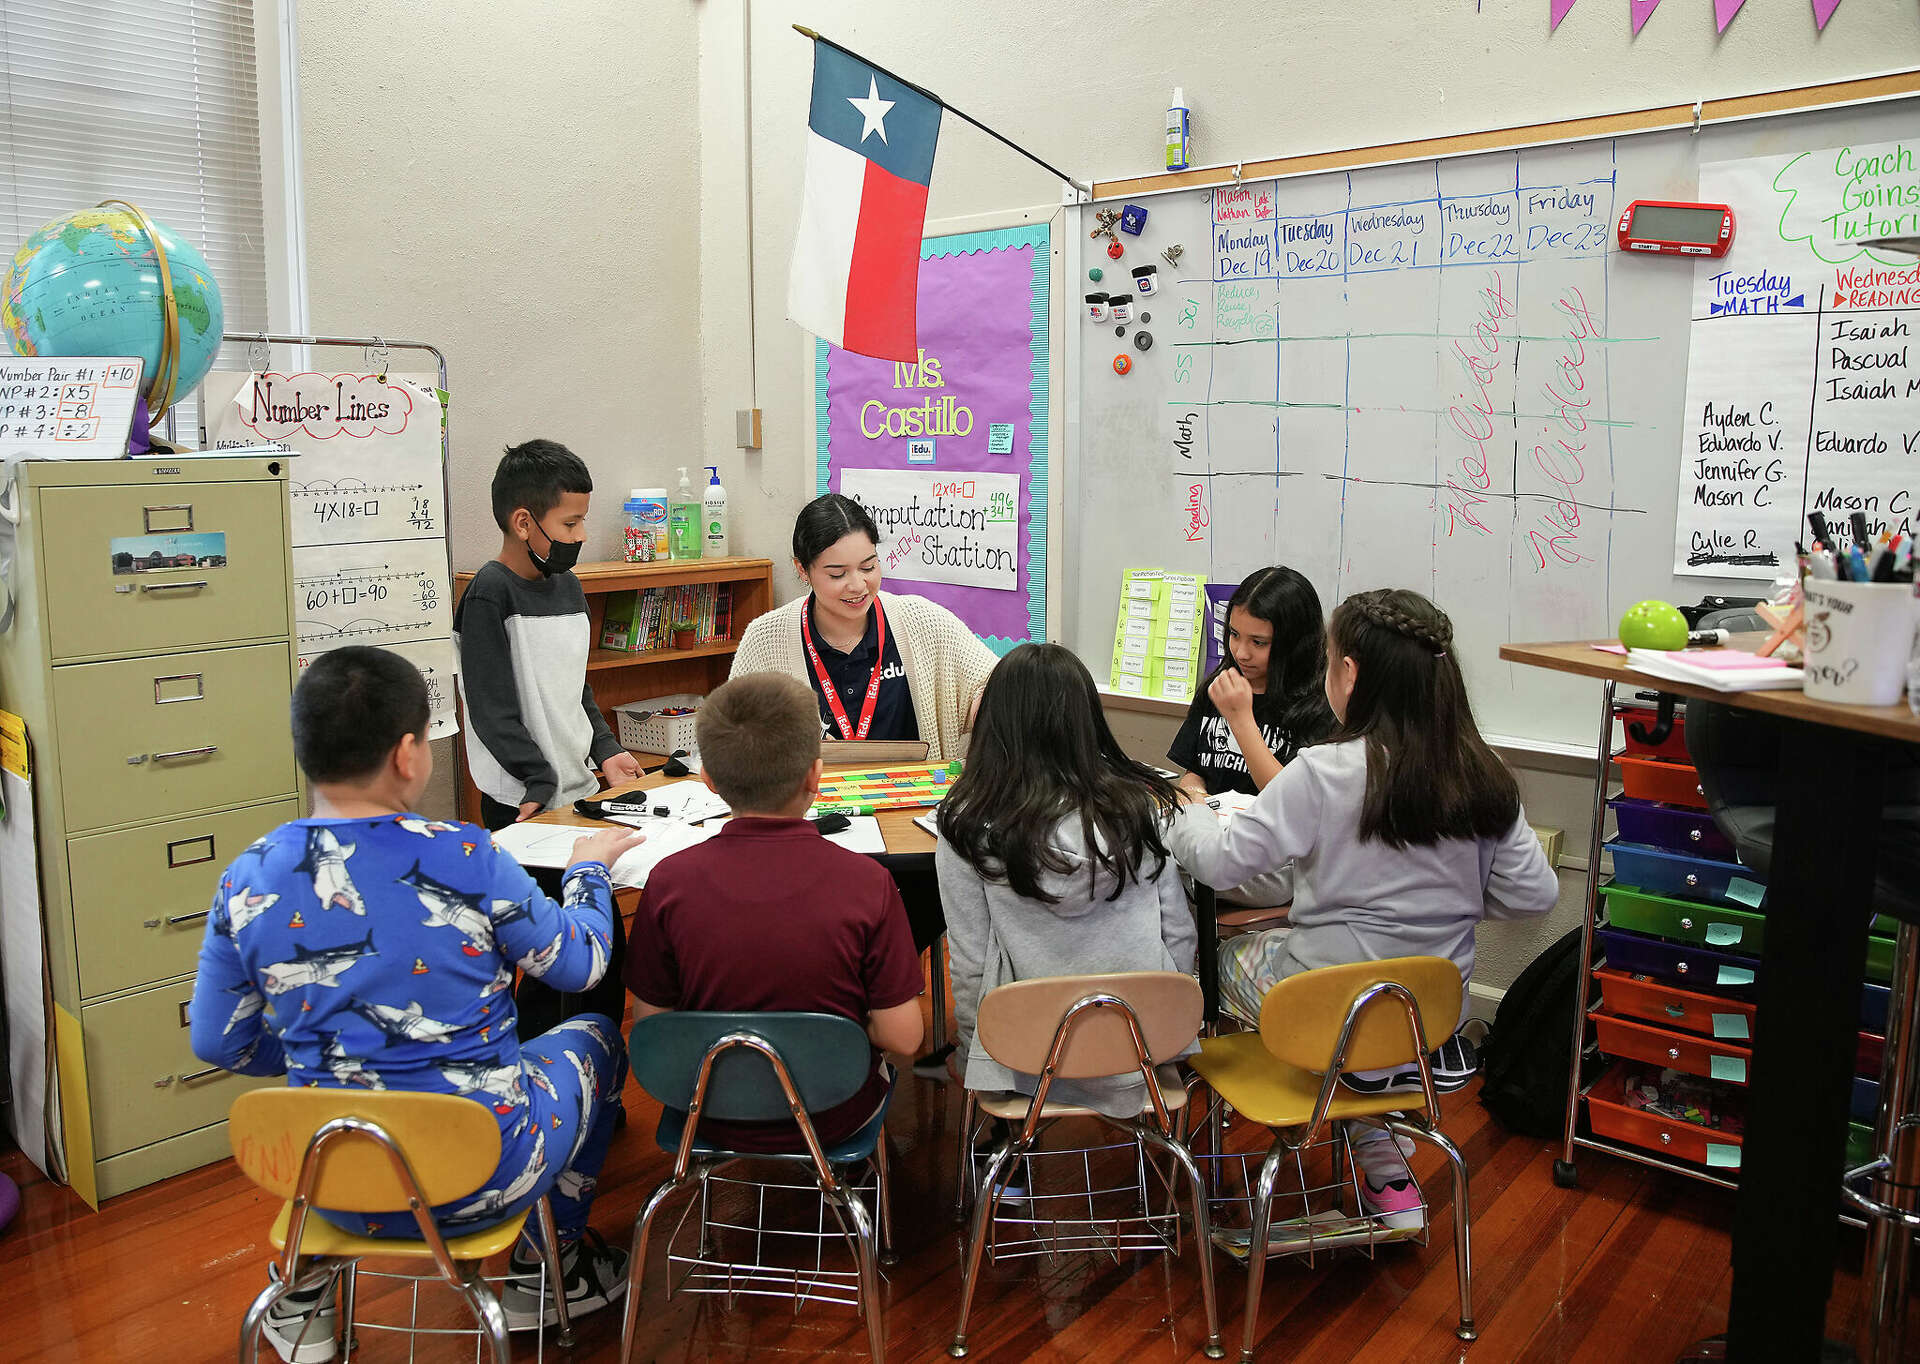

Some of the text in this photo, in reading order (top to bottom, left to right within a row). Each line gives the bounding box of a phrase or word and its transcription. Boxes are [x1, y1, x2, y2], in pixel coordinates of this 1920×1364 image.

[1835, 144, 1918, 180] Coach
[1216, 188, 1252, 207] Mason
[1528, 188, 1595, 217] Friday
[1351, 207, 1425, 235] Wednesday
[1442, 198, 1511, 226] Thursday
[1218, 229, 1270, 253] Monday
[1279, 219, 1334, 245] Tuesday
[1527, 223, 1607, 250] Dec 23
[1350, 241, 1418, 266] Dec 21
[1449, 232, 1519, 258] Dec 22
[1220, 249, 1271, 277] Dec 19
[1287, 249, 1340, 272] Dec 20
[1709, 269, 1791, 297] Tuesday
[1723, 295, 1779, 316] MATH
[1831, 317, 1911, 341] Isaiah
[1832, 346, 1908, 370] Pascual
[48, 366, 71, 381] Pair
[251, 380, 330, 424] Number
[335, 381, 390, 423] Lines
[1826, 378, 1896, 402] Isaiah
[860, 395, 974, 440] Castillo
[1703, 401, 1779, 436] Ayden C.
[1173, 411, 1199, 460] Math
[1698, 430, 1784, 453] Eduardo V.
[1816, 430, 1888, 455] Eduardo
[911, 443, 931, 454] iEdu.
[1694, 458, 1787, 482] Jennifer G.
[1694, 484, 1772, 507] Mason C.
[1814, 488, 1912, 513] Mason C.
[853, 493, 984, 534] omputation
[1183, 483, 1210, 542] Reading
[1811, 517, 1886, 536] aniah
[1744, 530, 1761, 549] R.
[922, 535, 1016, 572] Station
[821, 679, 834, 703] iEdu.
[867, 676, 880, 700] iEdu.
[837, 714, 849, 739] iEdu.
[857, 714, 871, 738] iEdu.
